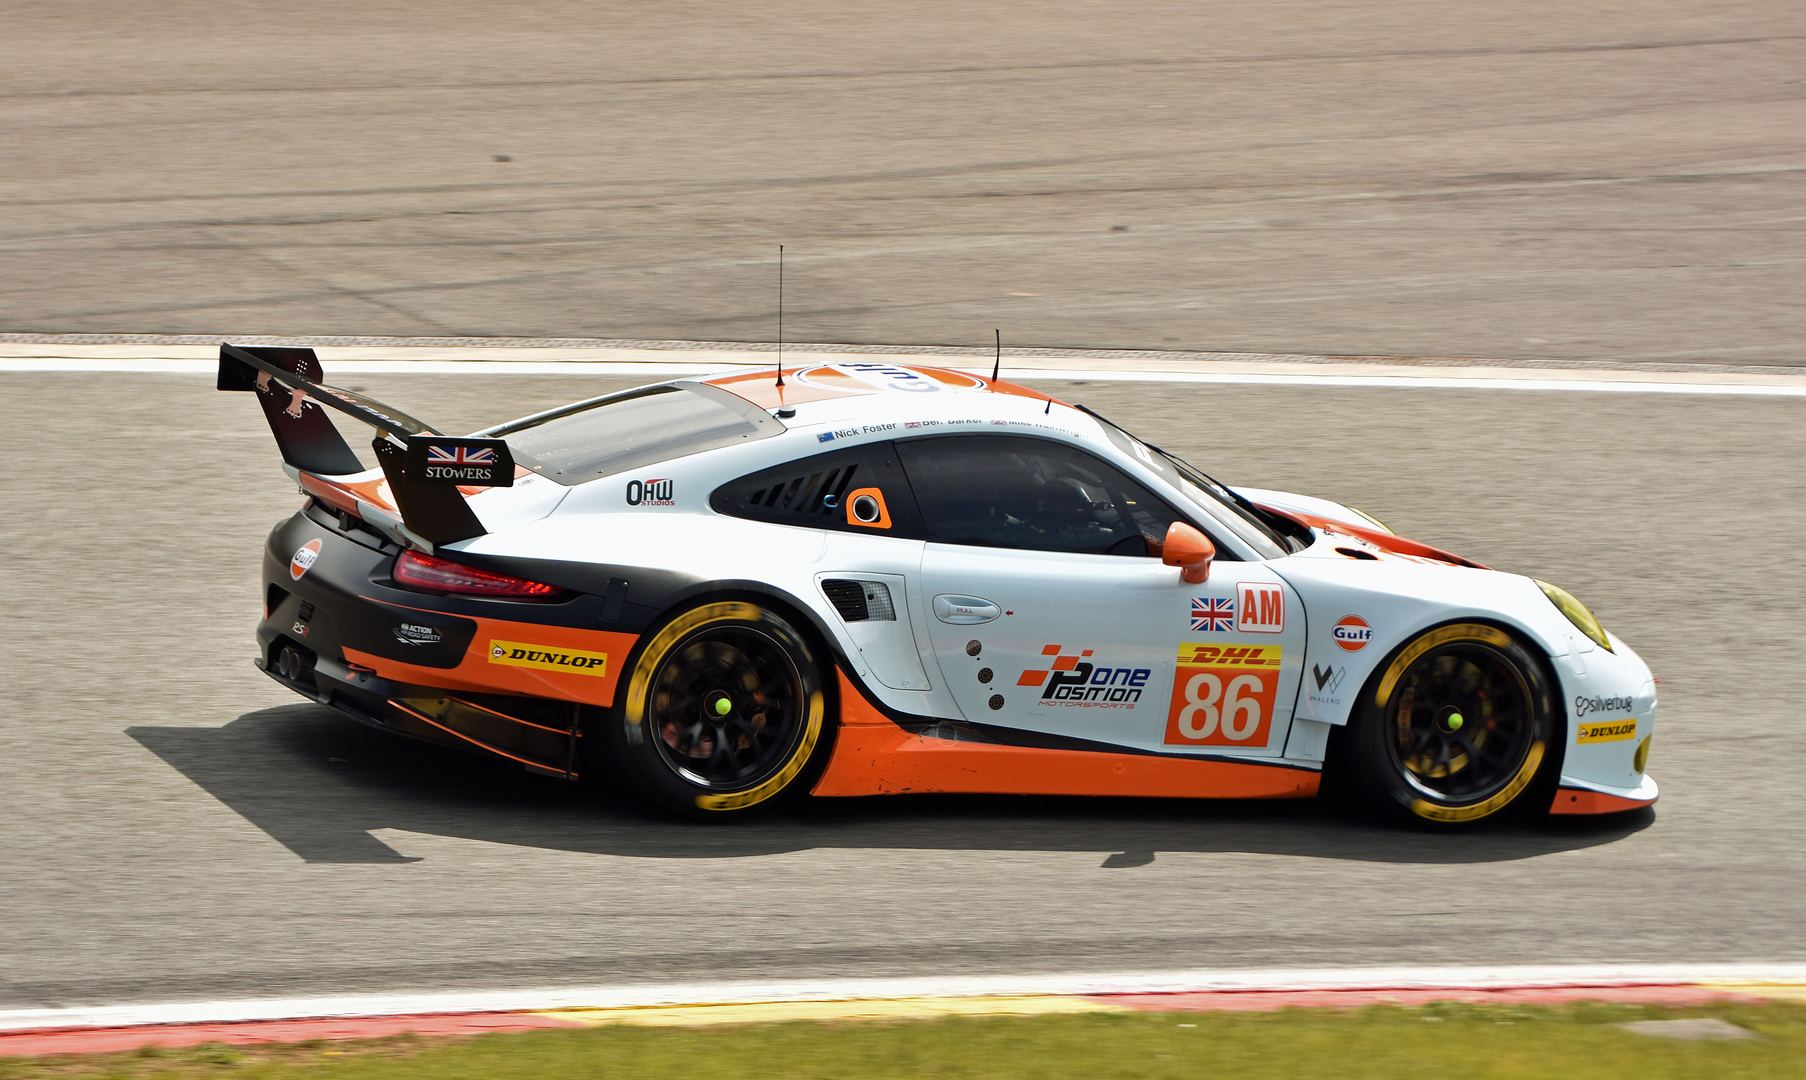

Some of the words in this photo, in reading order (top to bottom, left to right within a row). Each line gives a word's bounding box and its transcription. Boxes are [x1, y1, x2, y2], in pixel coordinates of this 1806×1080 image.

[834, 428, 860, 439] Nick
[862, 422, 897, 434] Foster
[425, 466, 492, 480] STOWERS
[626, 478, 673, 506] OHW
[294, 549, 316, 567] Gulf
[1241, 589, 1281, 626] AM
[410, 625, 432, 634] ACTION
[1333, 627, 1373, 640] Gulf
[508, 648, 604, 669] DUNLOP
[1191, 647, 1267, 665] DHL
[1038, 701, 1136, 709] MOTORSPORTS
[1178, 673, 1264, 740] 86
[1310, 695, 1341, 705] WALERO
[1589, 694, 1633, 713] silverbug
[1589, 724, 1636, 738] DUNLOP
